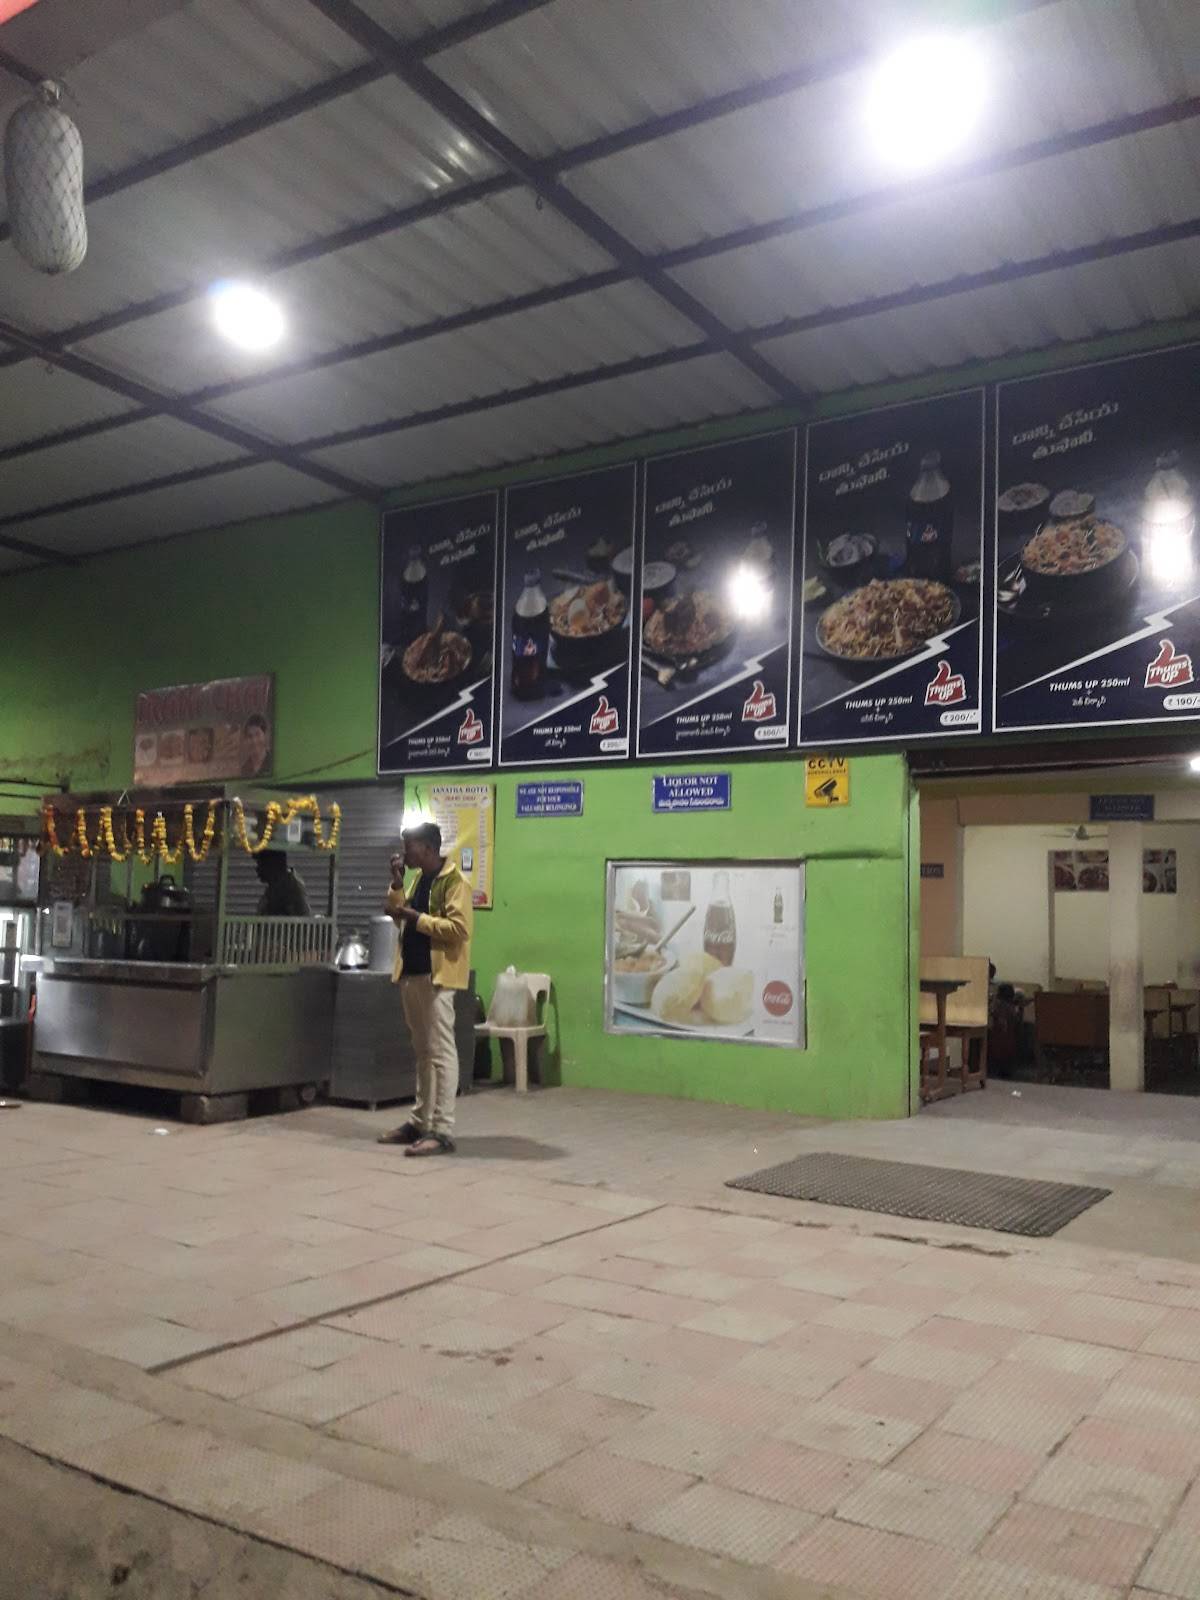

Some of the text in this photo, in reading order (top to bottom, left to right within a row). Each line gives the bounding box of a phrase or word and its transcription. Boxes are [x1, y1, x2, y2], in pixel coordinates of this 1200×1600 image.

[1149, 661, 1188, 678] Thums
[929, 681, 962, 697] Thums
[1049, 677, 1131, 692] THUMS UP 250ml
[845, 695, 913, 709] THUMS UP 250ml
[676, 716, 699, 725] THUMS
[700, 715, 710, 723] UP
[663, 776, 718, 787] LIQUOR NOT
[669, 787, 714, 798] ALLOWED
